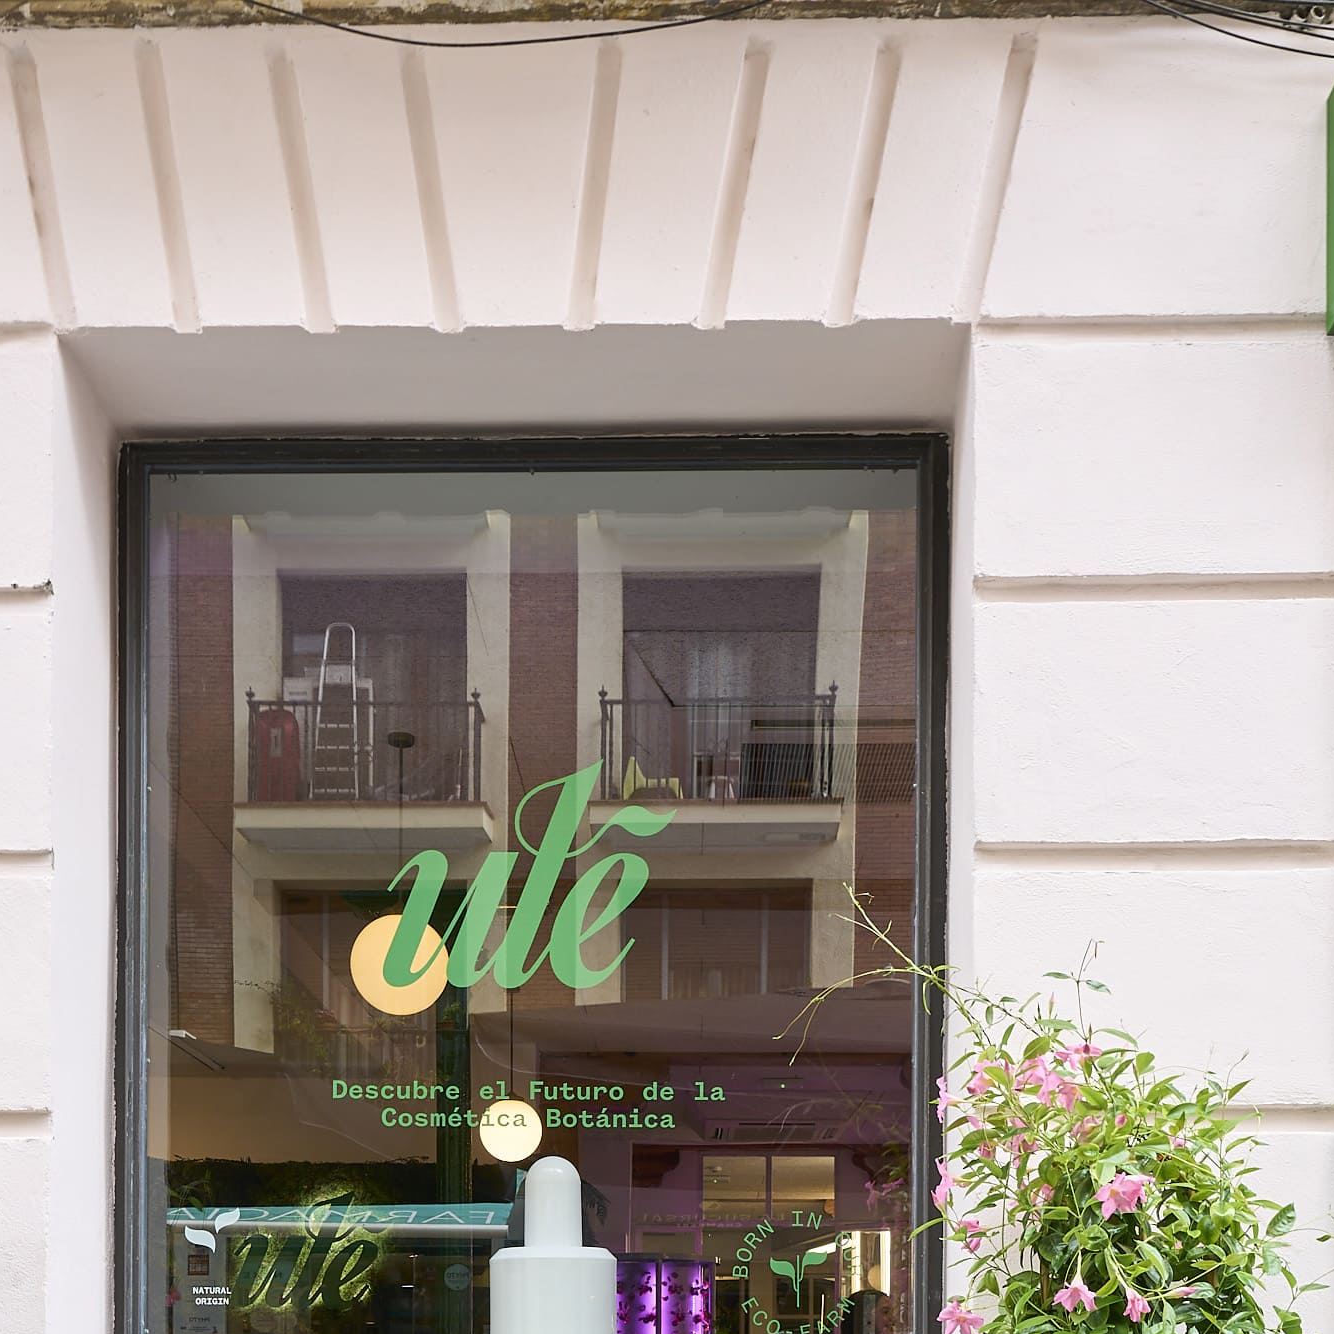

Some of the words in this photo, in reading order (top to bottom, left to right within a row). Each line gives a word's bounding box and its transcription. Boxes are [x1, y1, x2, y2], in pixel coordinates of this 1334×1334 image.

[332, 1079, 460, 1100] Descubre
[479, 1080, 510, 1100] el
[529, 1080, 624, 1101] Futuro
[643, 1081, 675, 1101] de
[694, 1081, 726, 1101] la
[381, 1107, 527, 1128] Cosmética
[546, 1107, 676, 1128] Botánica
[732, 1219, 775, 1278] BORN
[791, 1210, 823, 1230] IN
[192, 1286, 233, 1295] NATURAL
[195, 1297, 230, 1305] ORIGIN
